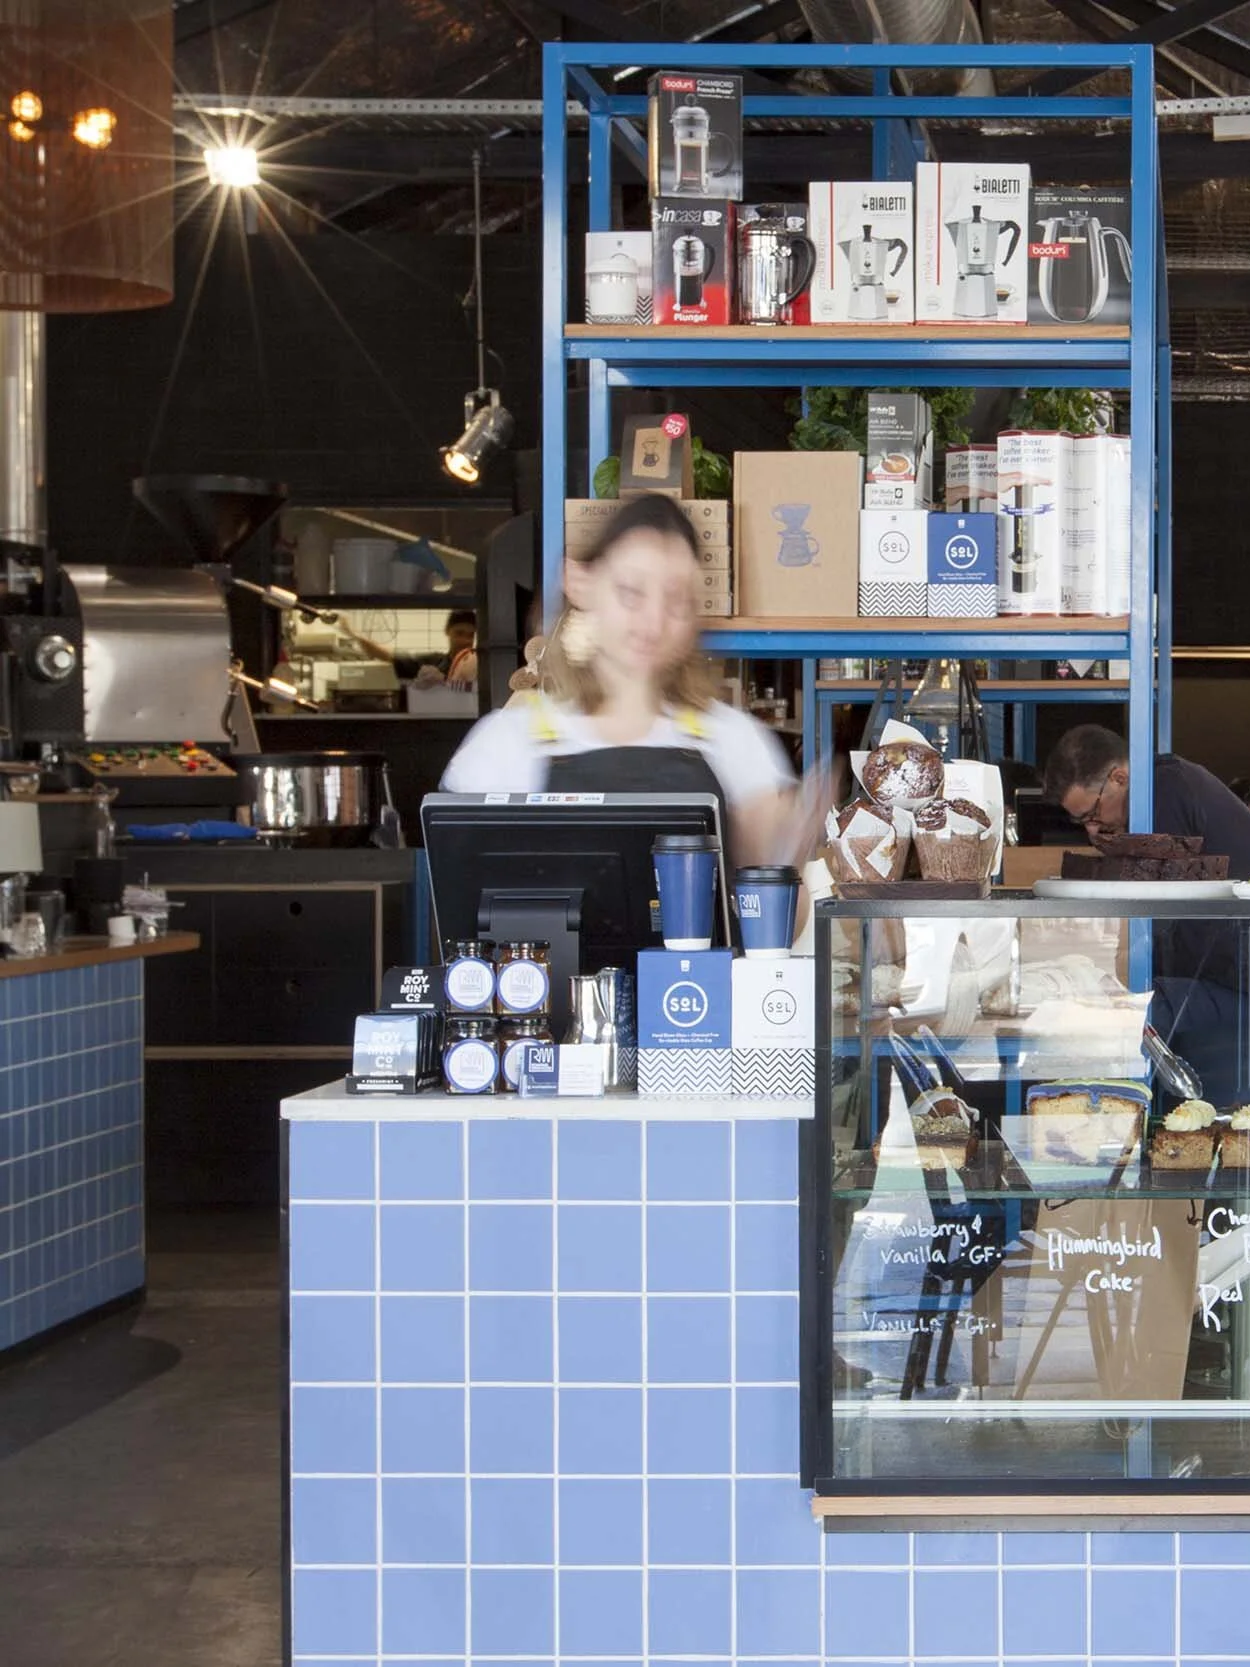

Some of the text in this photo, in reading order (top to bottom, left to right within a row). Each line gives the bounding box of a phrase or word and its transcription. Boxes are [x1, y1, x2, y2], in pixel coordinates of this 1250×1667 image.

[673, 313, 709, 323] Plunger
[404, 976, 428, 985] ROY
[401, 985, 430, 994] MINT
[371, 1031, 401, 1043] ROY
[1047, 1222, 1162, 1271] Hummingbird
[881, 1246, 946, 1265] Vanilla
[1085, 1269, 1133, 1293] Cake
[1200, 1279, 1243, 1333] Red
